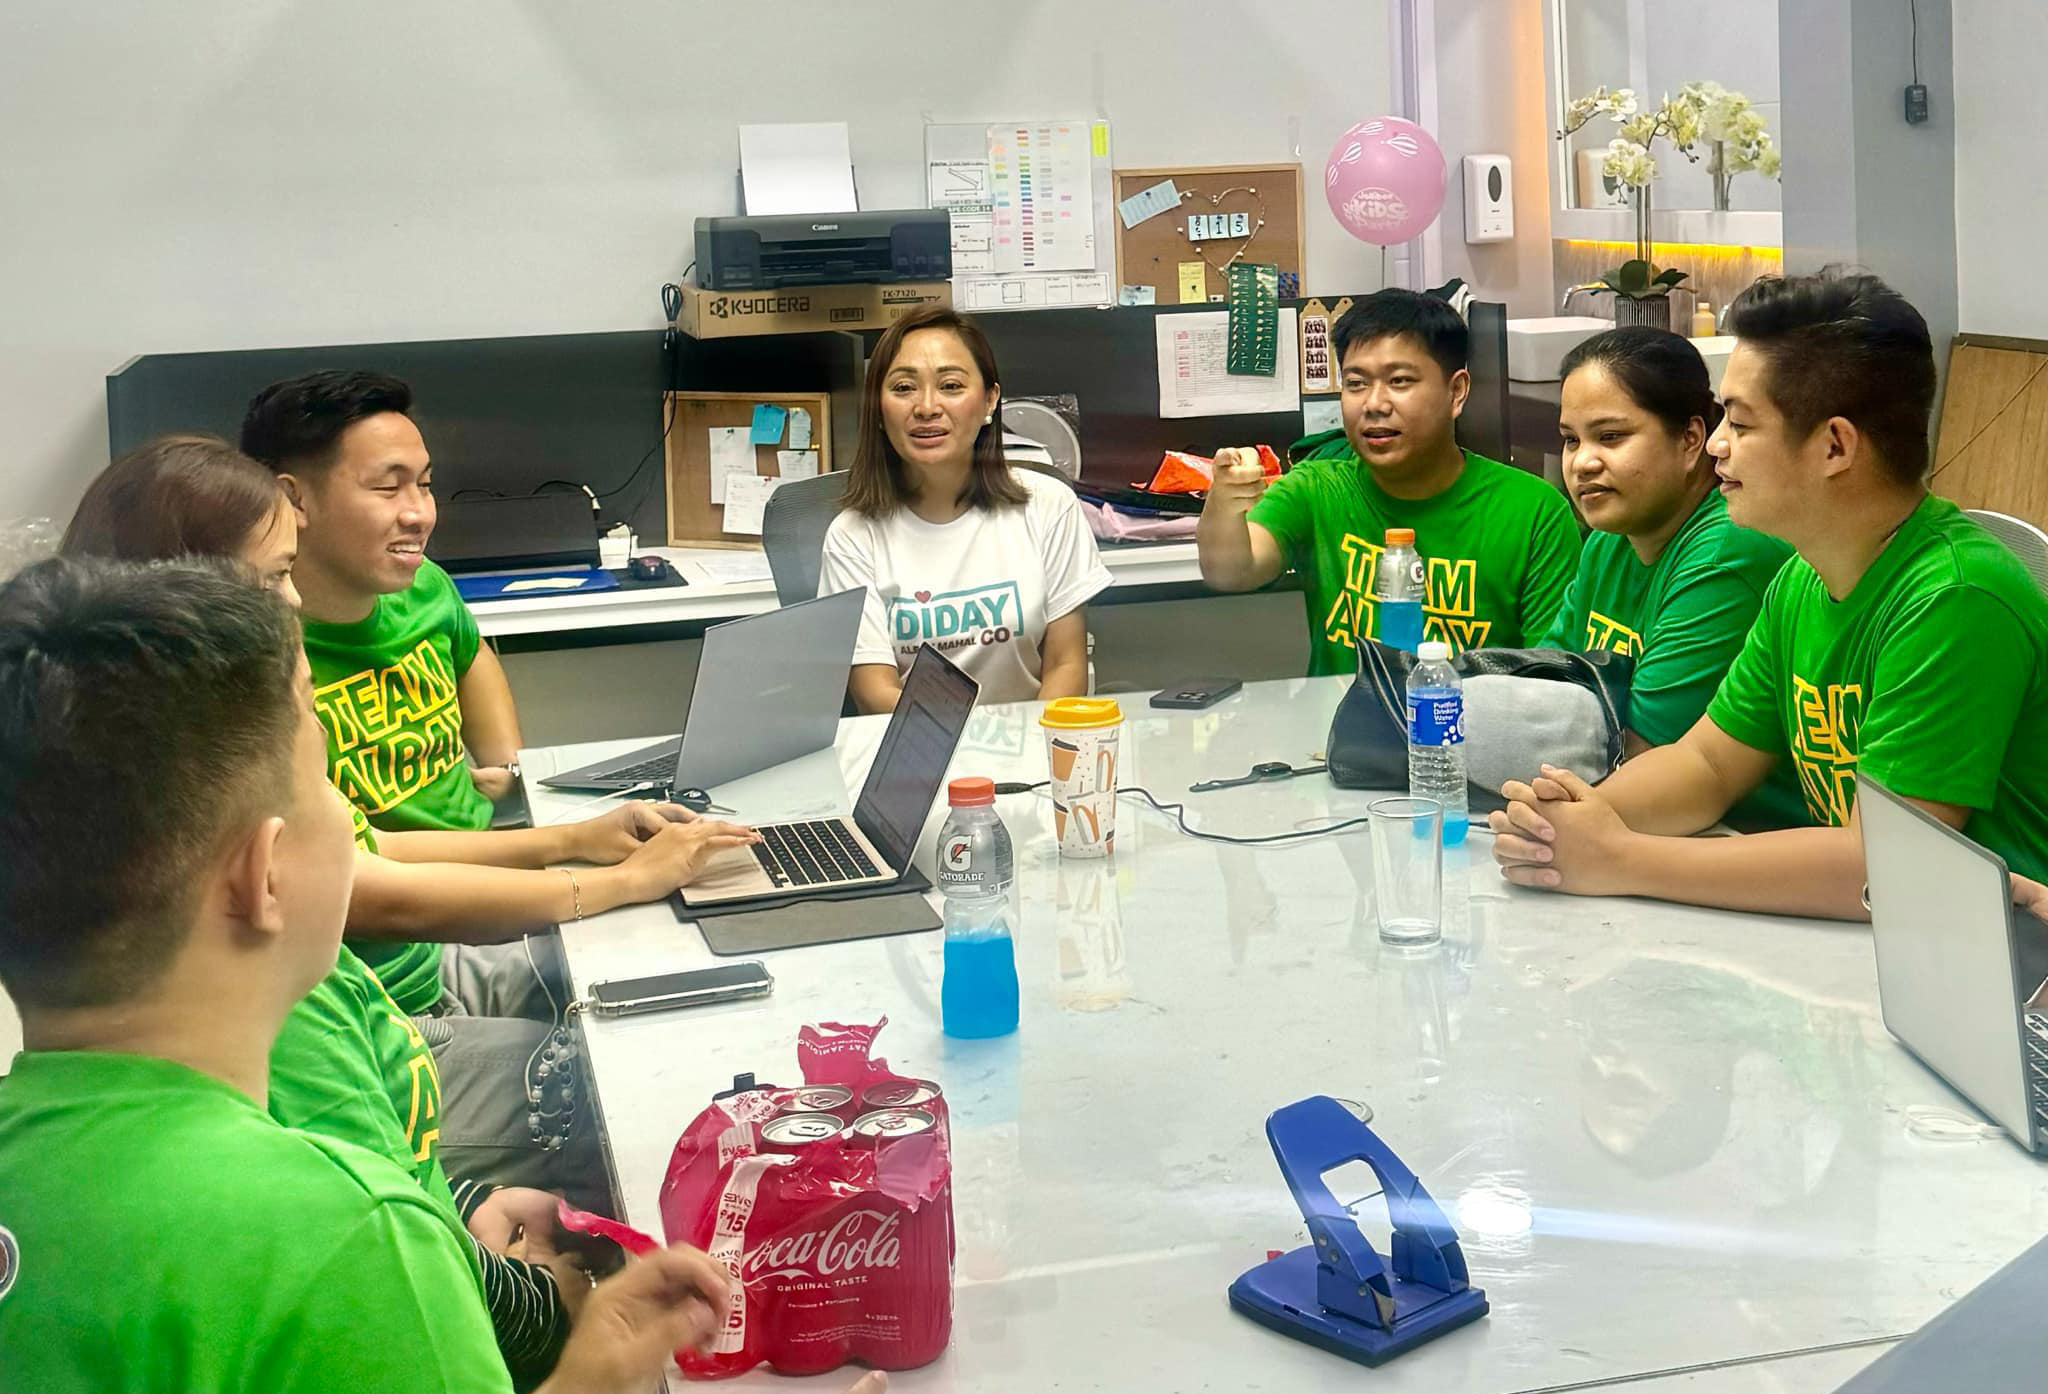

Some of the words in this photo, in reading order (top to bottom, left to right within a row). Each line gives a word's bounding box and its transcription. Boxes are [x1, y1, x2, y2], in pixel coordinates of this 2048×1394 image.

[1235, 220, 1244, 233] 5
[896, 593, 1009, 641] DIDAY
[937, 637, 977, 652] MAHAL
[980, 626, 1011, 646] CO
[312, 639, 457, 753] TEAM
[943, 834, 973, 872] G
[777, 1282, 831, 1292] ORIGINAL
[834, 1275, 868, 1287] TASTE
